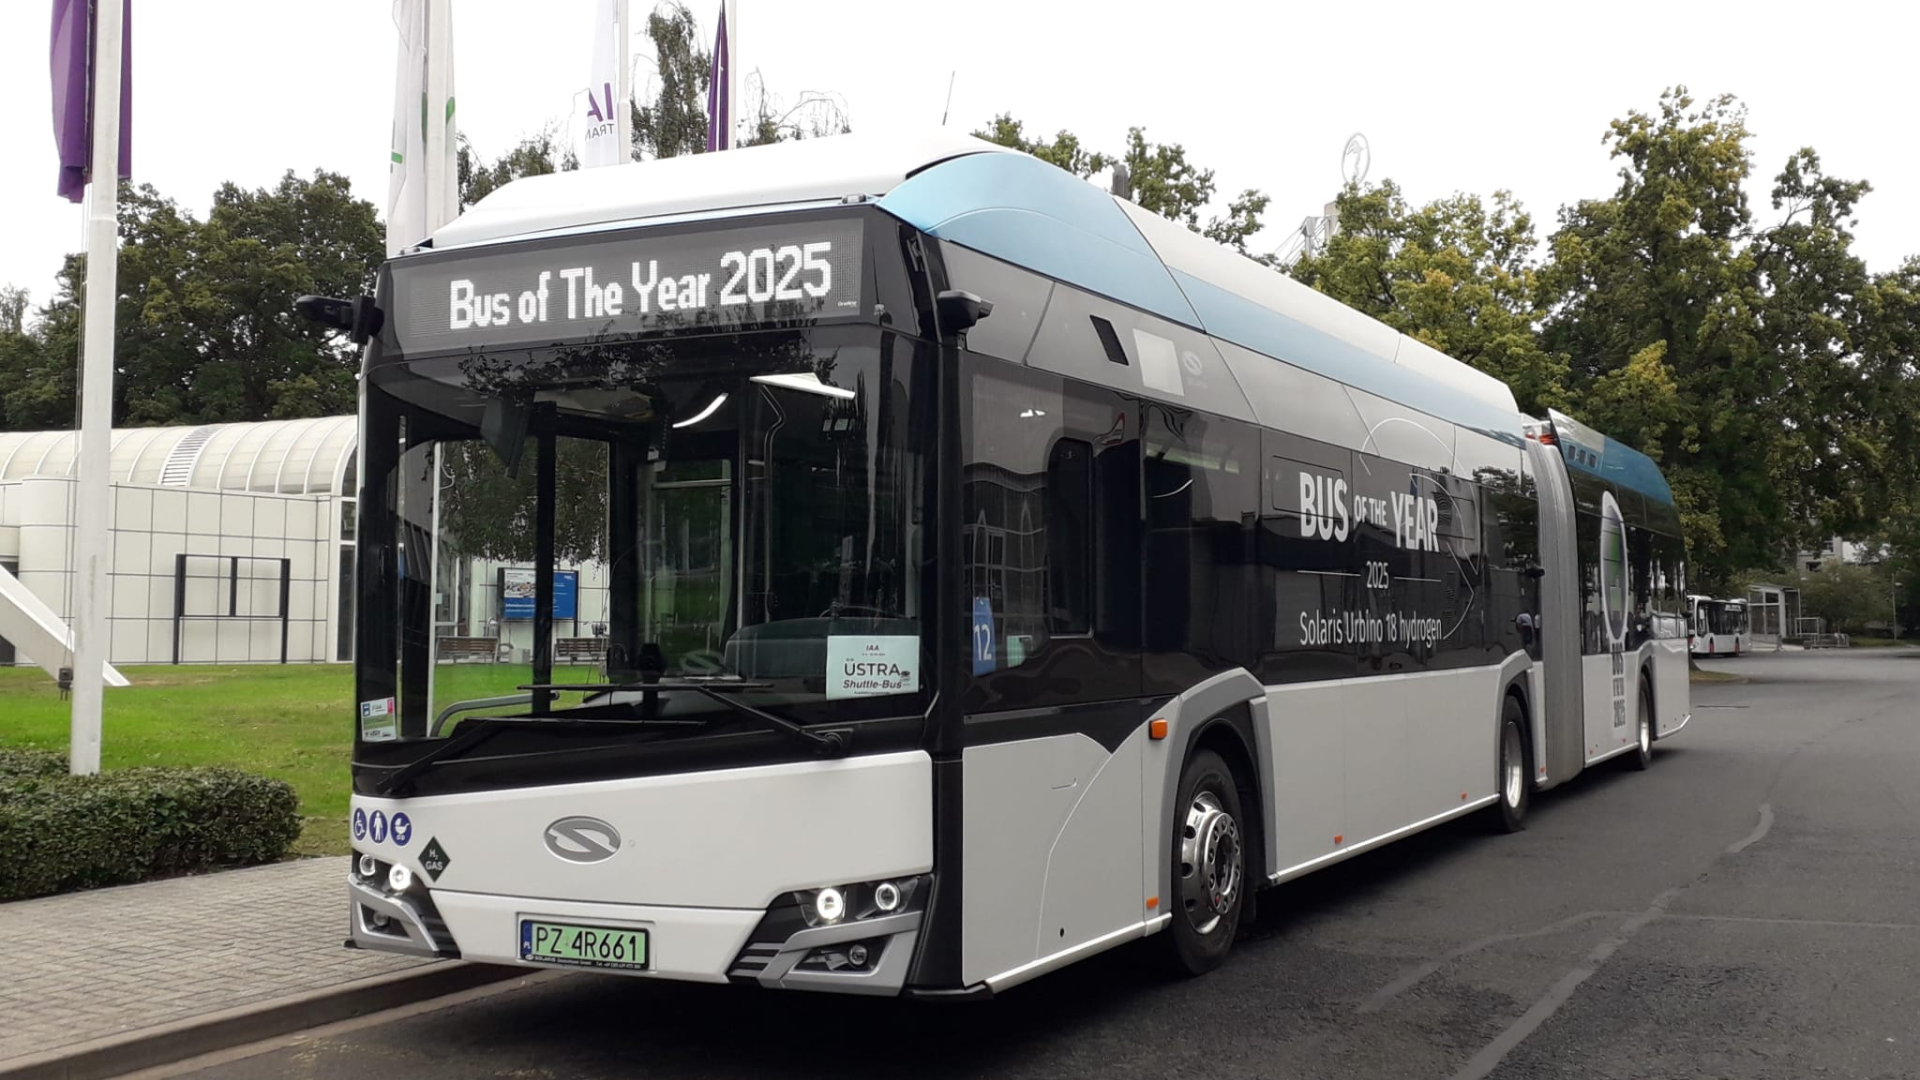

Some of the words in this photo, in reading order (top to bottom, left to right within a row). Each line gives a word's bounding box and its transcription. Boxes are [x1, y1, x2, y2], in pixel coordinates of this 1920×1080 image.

[449, 278, 510, 330] Bus
[517, 271, 551, 323] of
[560, 266, 623, 319] The
[631, 259, 711, 313] Year
[720, 242, 832, 306] 2025
[1299, 471, 1350, 543] BUS
[1353, 494, 1367, 523] OF
[1369, 497, 1388, 527] THE
[1390, 490, 1440, 553] YEAR
[1366, 560, 1389, 590] 2025
[974, 623, 992, 661] 12
[1299, 608, 1343, 646] Solaris
[1344, 608, 1384, 645] Urbino
[1385, 612, 1398, 643] 18
[1399, 610, 1442, 650] hydrogen
[842, 679, 902, 690] Shuttle-Bus
[844, 657, 901, 677] ÜSTRA
[425, 861, 443, 870] GAS
[536, 926, 563, 955] PZ
[571, 930, 637, 962] 4R661
